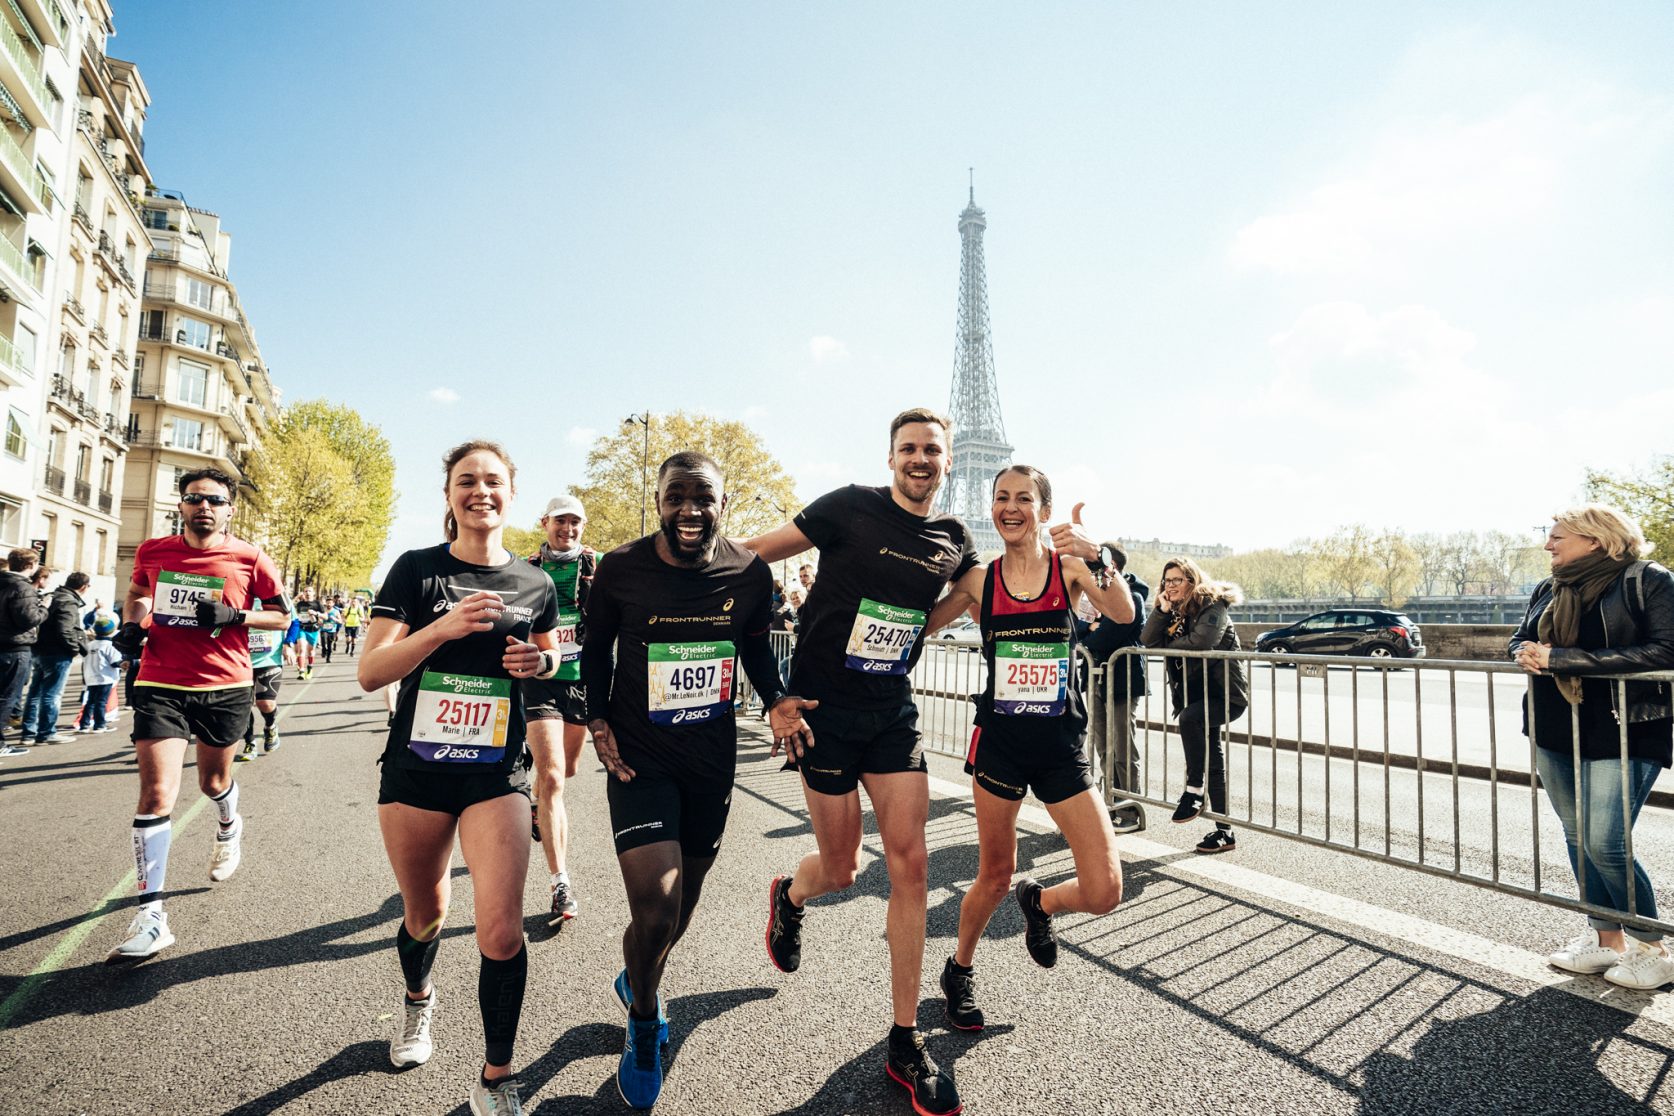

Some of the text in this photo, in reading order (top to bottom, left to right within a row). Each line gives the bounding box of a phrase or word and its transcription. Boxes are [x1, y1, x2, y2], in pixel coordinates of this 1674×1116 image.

[174, 573, 210, 583] Schneider
[878, 605, 915, 619] Schneider
[513, 613, 532, 624] FRANCE
[660, 615, 732, 623] FRONTRUNNER
[863, 623, 911, 647] 25470
[669, 645, 717, 654] Schneider
[1012, 644, 1054, 652] Schneider
[670, 665, 716, 691] 4697
[1007, 663, 1057, 686] 25575
[442, 676, 493, 689] Schneider
[463, 686, 492, 695] Electric
[435, 699, 492, 727] 25117
[442, 725, 460, 734] Marie
